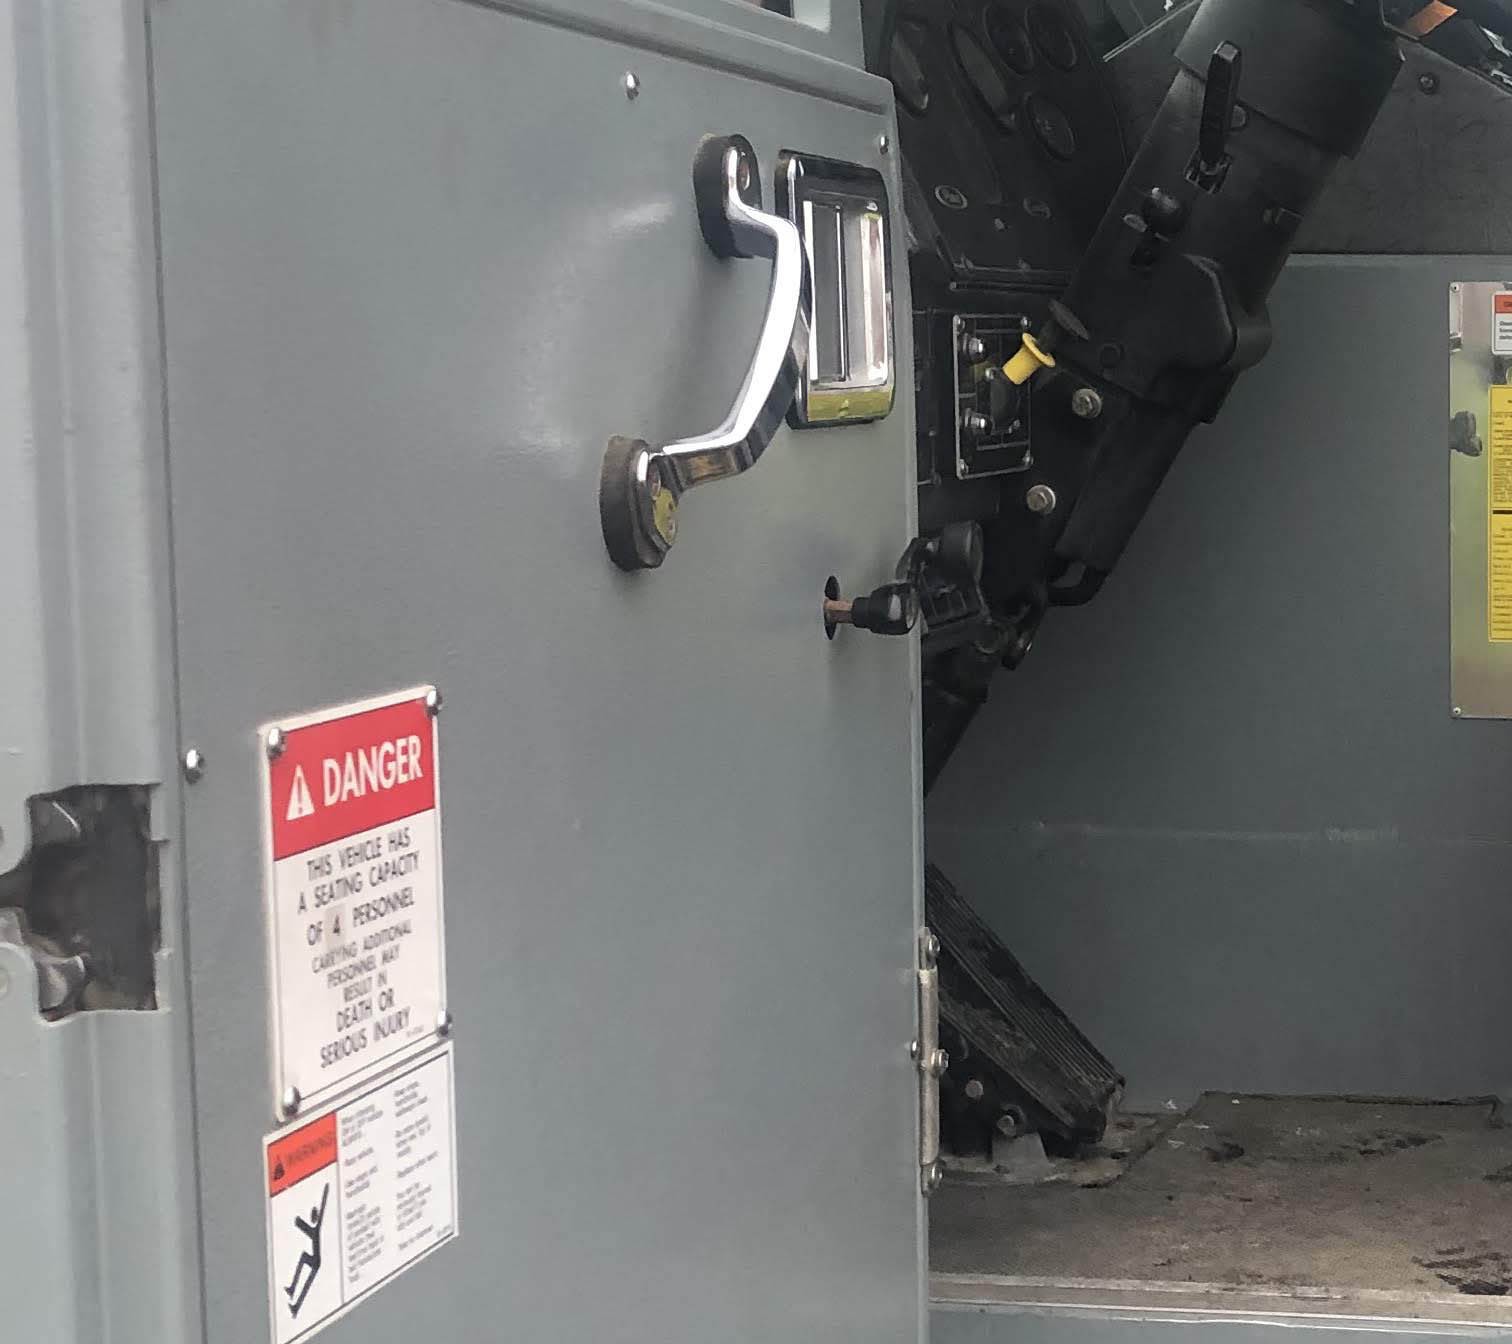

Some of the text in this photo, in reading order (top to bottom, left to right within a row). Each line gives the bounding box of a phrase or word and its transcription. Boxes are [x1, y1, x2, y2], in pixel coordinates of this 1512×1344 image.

[322, 735, 423, 807] DANGER
[306, 826, 411, 881] THIS VEHICLE HAS
[298, 850, 420, 915] A SEATING CAPACITY
[307, 886, 415, 946] OF 4 PERSONNEL
[312, 919, 412, 974] CARRYING ADDITIONAL
[327, 955, 377, 989] PERSONNEL
[320, 1006, 411, 1069] SERIOUS INJURY
[336, 997, 373, 1033] DEATH
[378, 988, 395, 1012] OR
